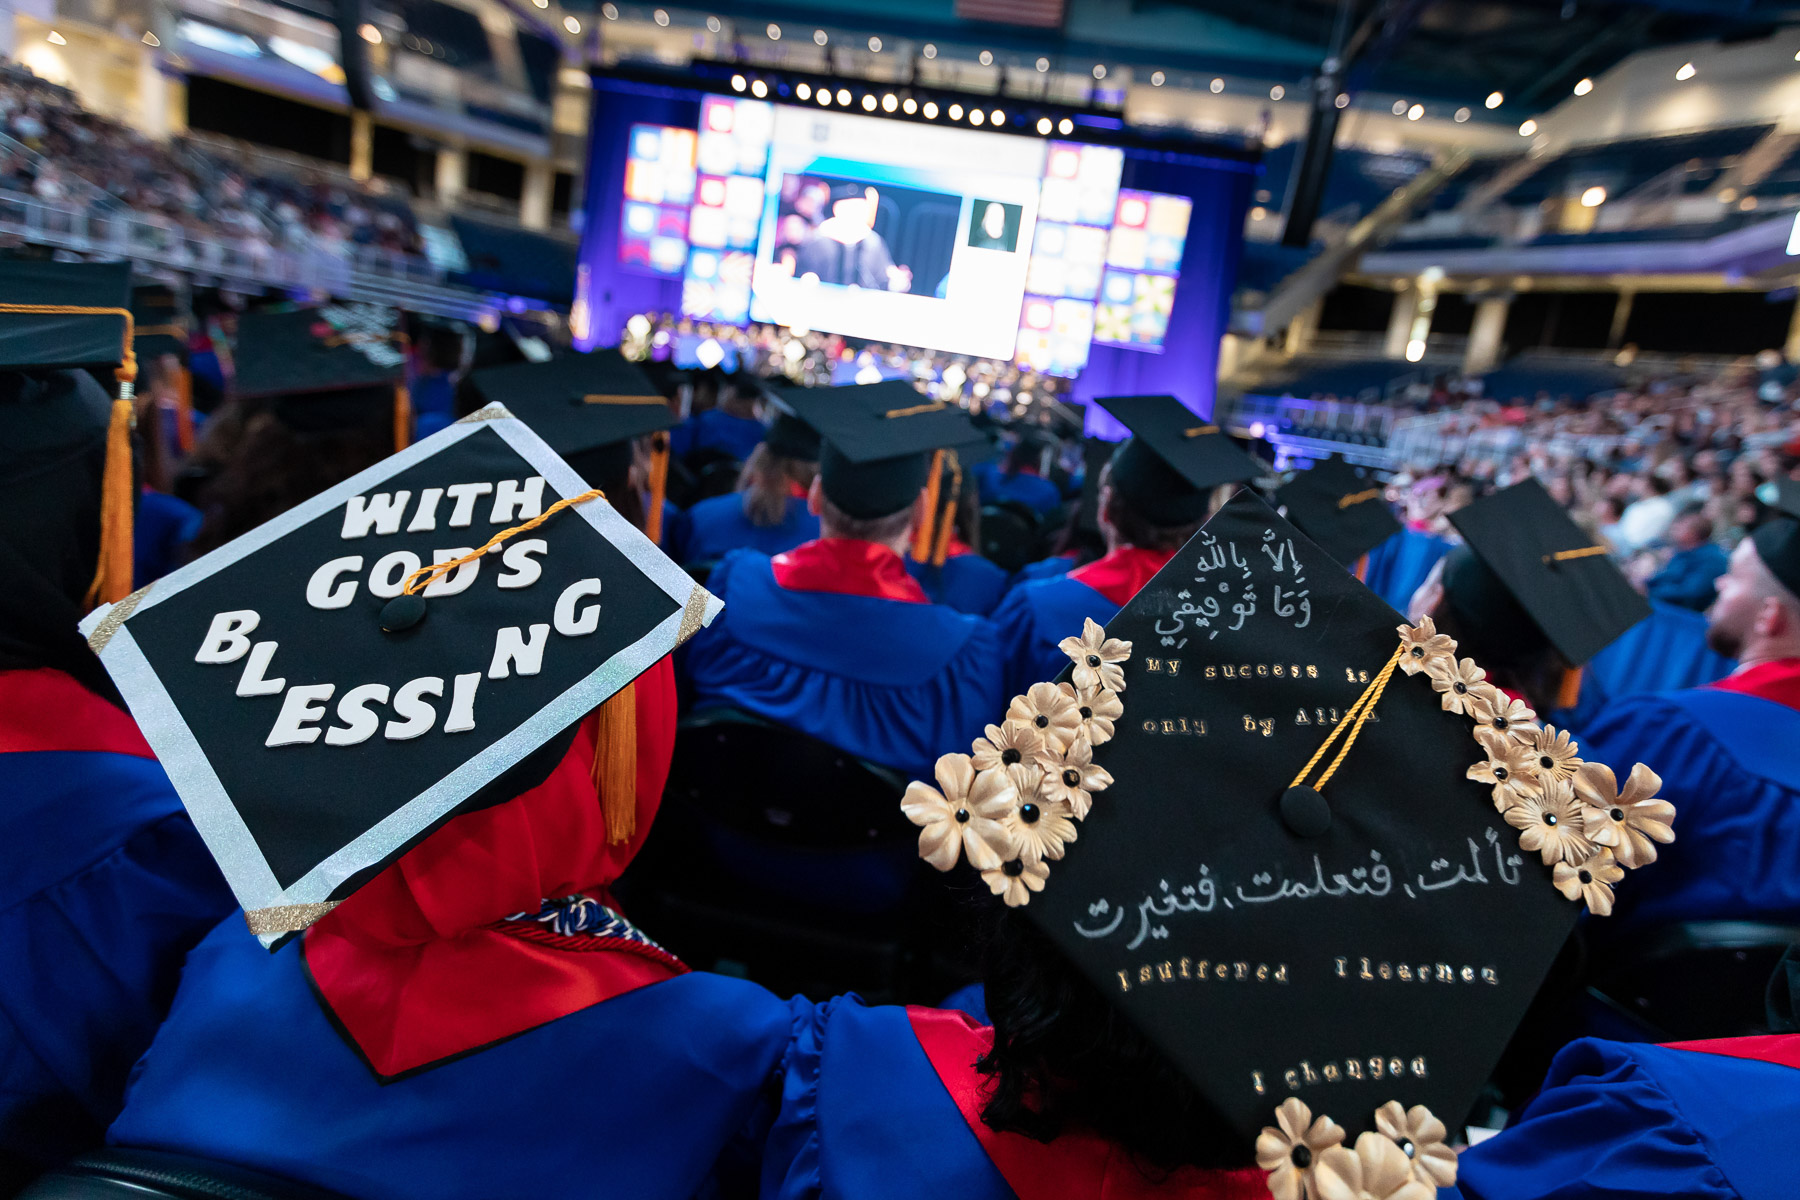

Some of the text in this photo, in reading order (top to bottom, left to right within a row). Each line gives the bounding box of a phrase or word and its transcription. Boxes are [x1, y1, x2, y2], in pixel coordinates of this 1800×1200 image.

[340, 476, 546, 540] WITH
[306, 539, 548, 610] GOD'S
[194, 577, 602, 748] BLESSING
[1146, 657, 1370, 684] My success is
[1142, 707, 1380, 737] only by All
[1251, 1055, 1429, 1095] I changed
